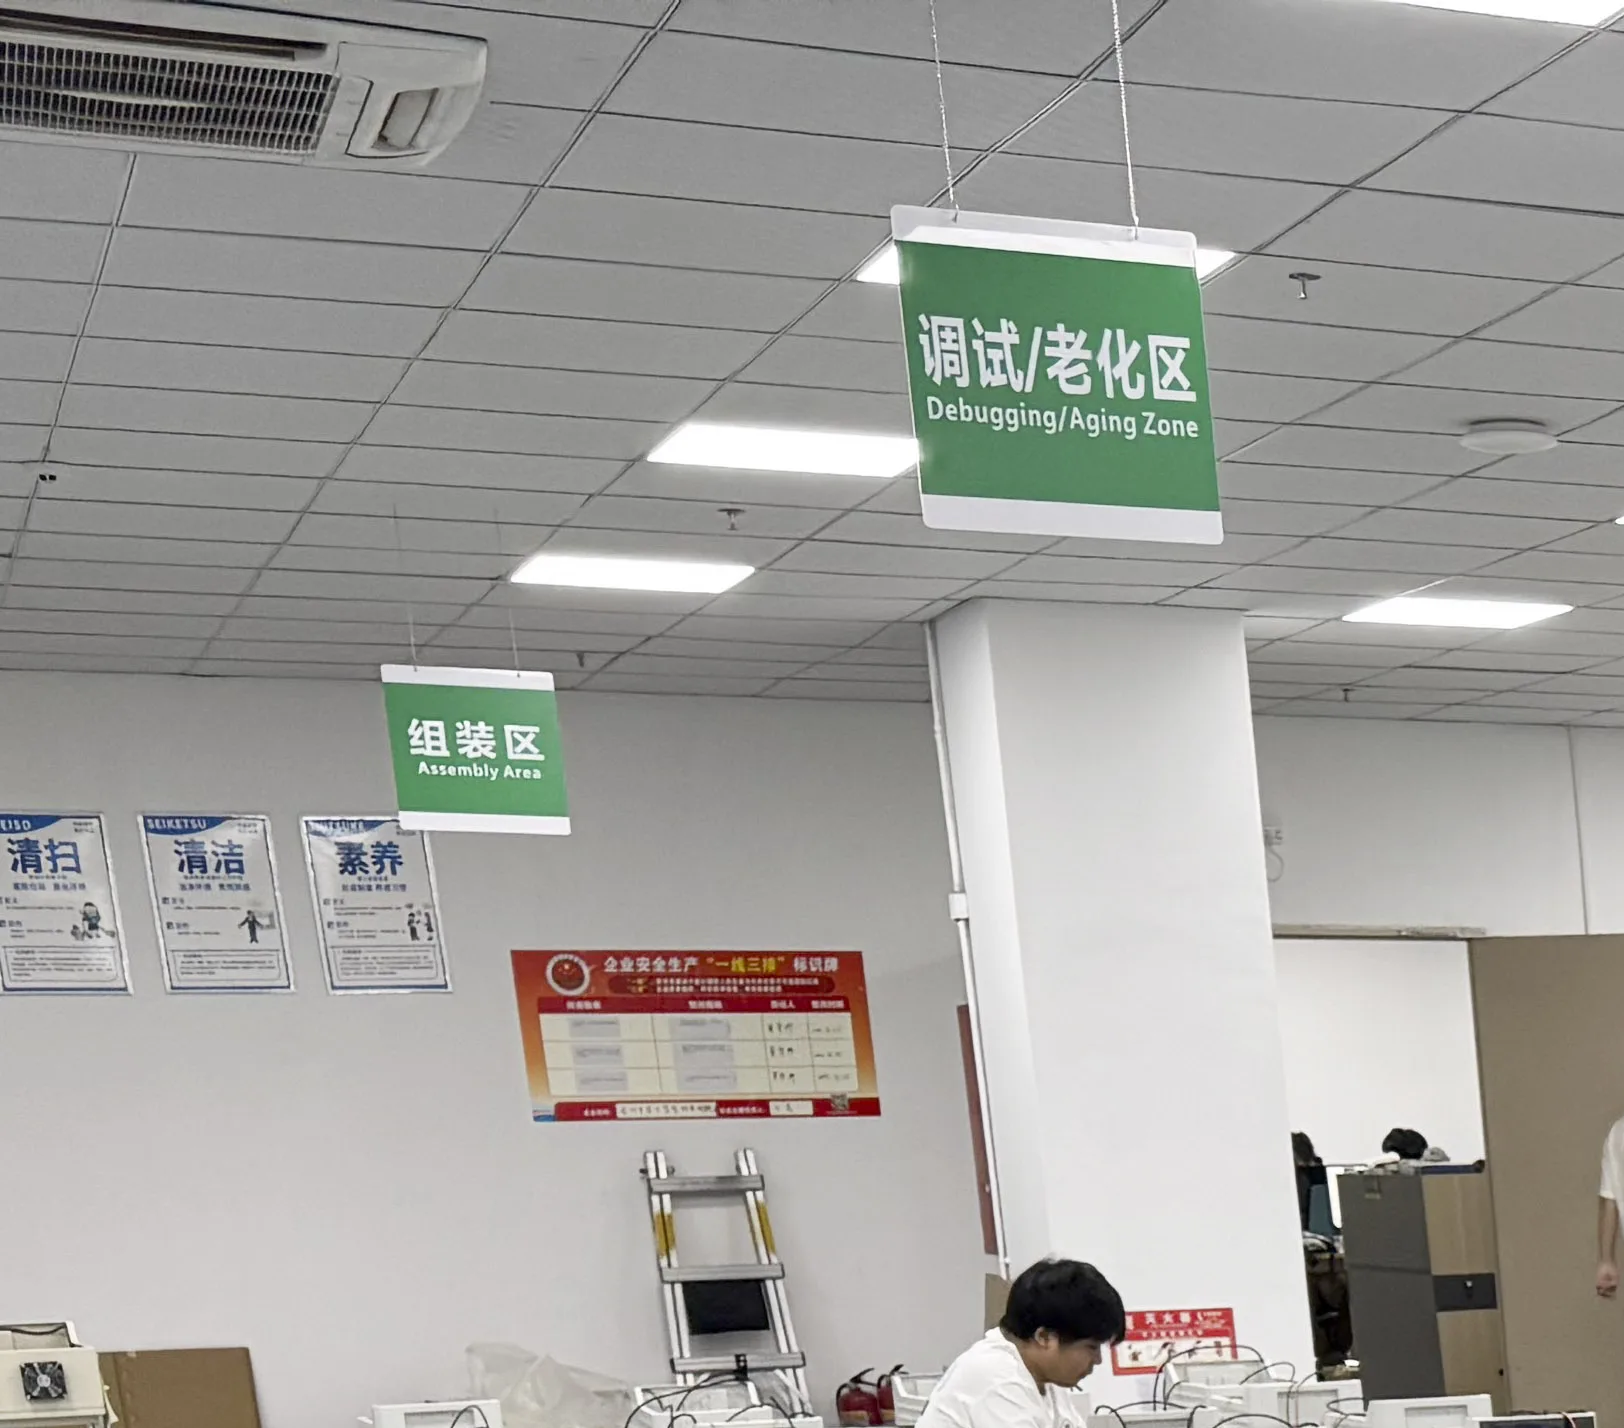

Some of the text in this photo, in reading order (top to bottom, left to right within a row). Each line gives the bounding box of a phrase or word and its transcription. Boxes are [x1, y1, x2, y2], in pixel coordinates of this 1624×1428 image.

[918, 313, 1197, 402] 调试/老化区
[926, 396, 1199, 439] Debugging/Aging Zone
[407, 718, 545, 761] 组装区
[418, 761, 542, 781] Assembly Area
[7, 837, 82, 874] 清扫
[173, 839, 245, 875] 清洁
[333, 841, 404, 876] 素养
